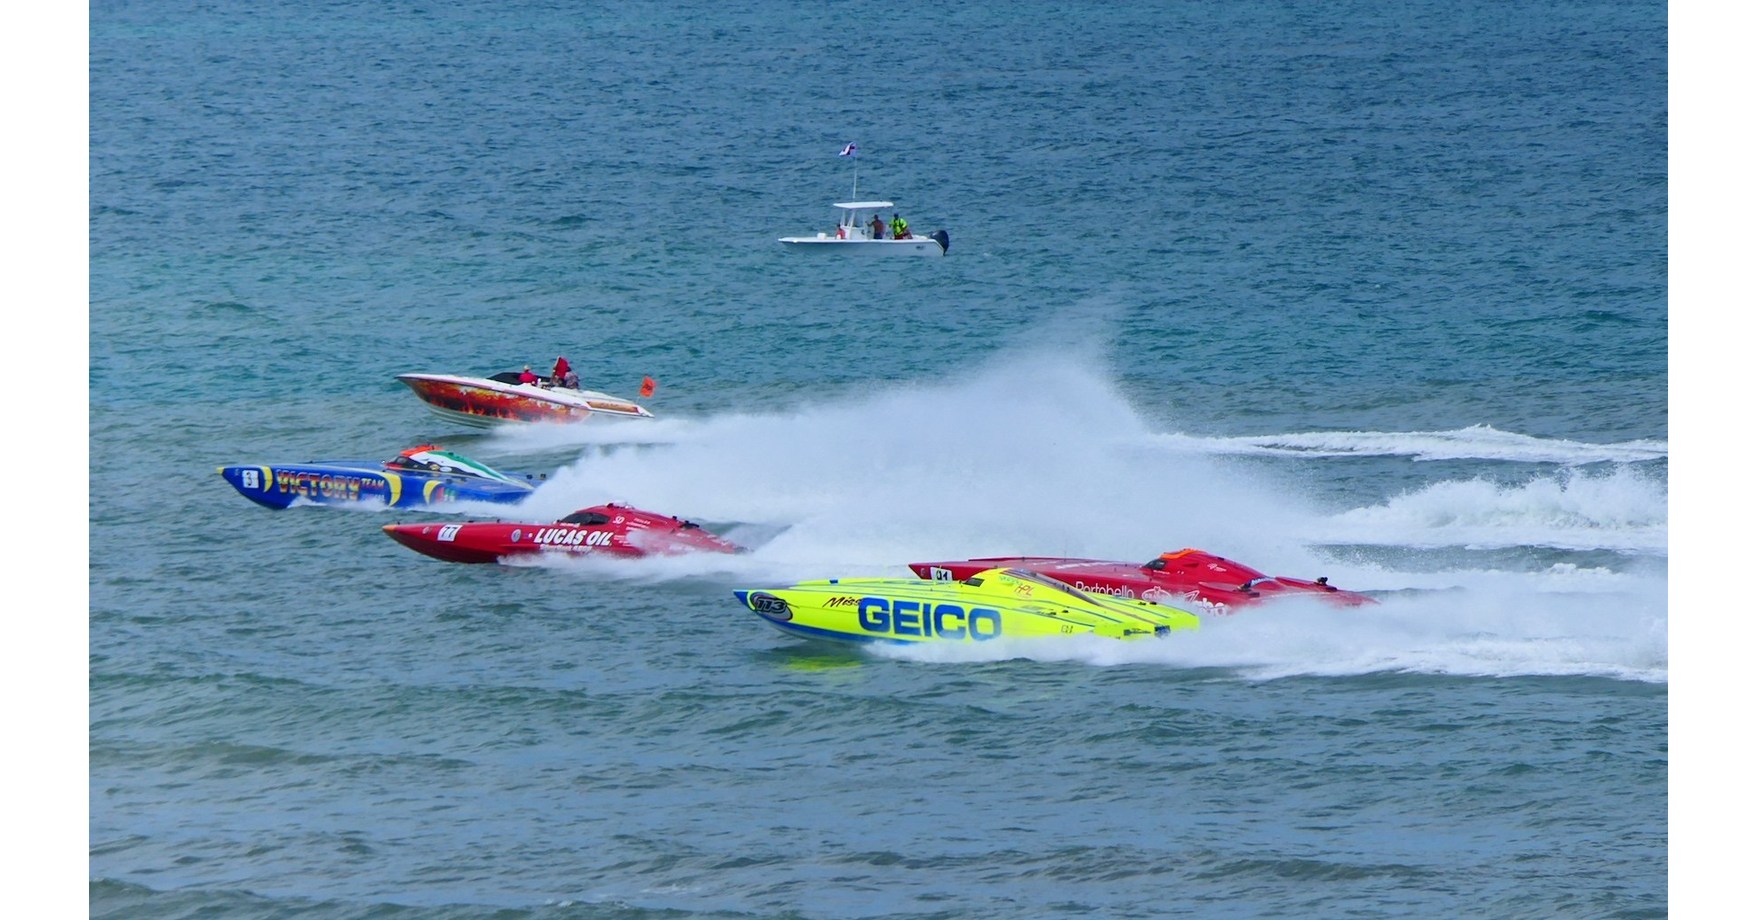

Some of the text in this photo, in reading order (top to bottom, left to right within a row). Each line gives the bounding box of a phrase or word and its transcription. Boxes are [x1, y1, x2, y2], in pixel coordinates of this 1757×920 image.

[276, 468, 386, 501] VICTORY TEAM
[440, 525, 458, 539] 77
[533, 527, 588, 546] LUCAS
[585, 530, 615, 547] OIL
[756, 596, 787, 614] 113
[821, 596, 862, 609] Miss
[858, 595, 1003, 642] GEICO
